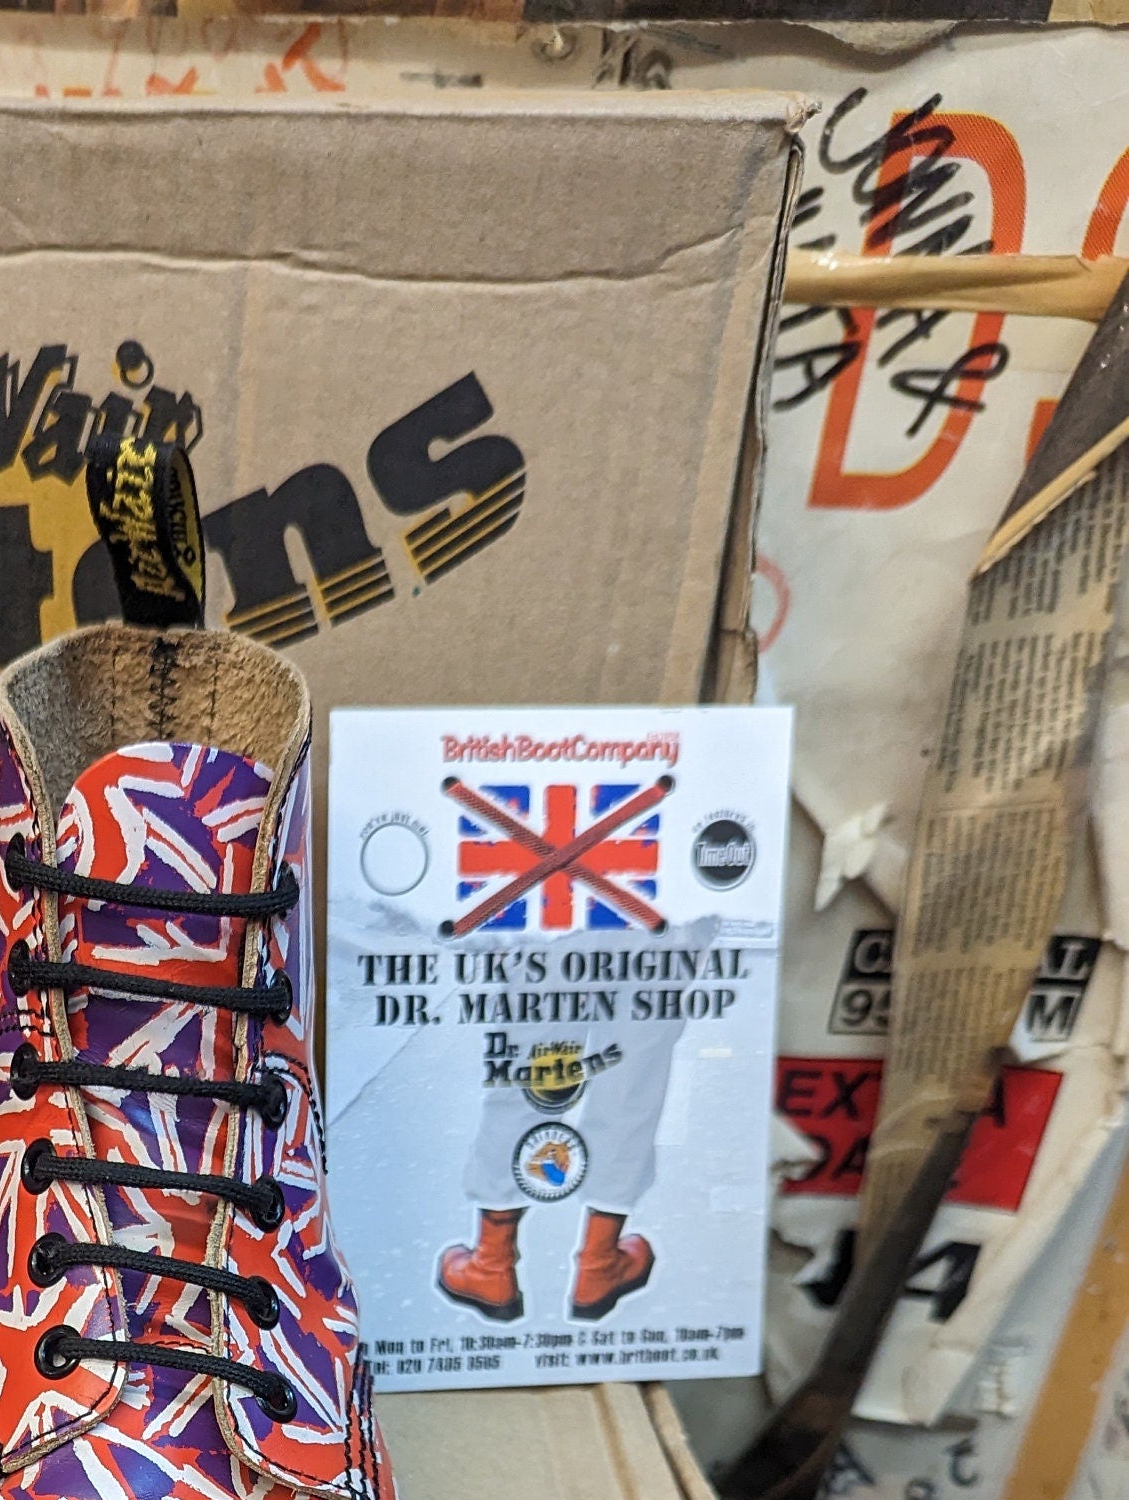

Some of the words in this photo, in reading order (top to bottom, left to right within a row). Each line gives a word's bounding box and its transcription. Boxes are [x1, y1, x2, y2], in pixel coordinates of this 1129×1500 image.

[441, 733, 679, 769] BritishBootCompany
[358, 953, 438, 987] THE
[454, 950, 547, 985] UK'S
[561, 948, 750, 982] ORIGINAL
[374, 993, 442, 1027] DR.
[458, 990, 618, 1025] MARTEN
[631, 988, 737, 1022] SHOP
[482, 1043, 623, 1087] Martens
[375, 1340, 404, 1355] Mon
[410, 1339, 425, 1354] to
[591, 1331, 614, 1346] Sat
[620, 1331, 635, 1345] to
